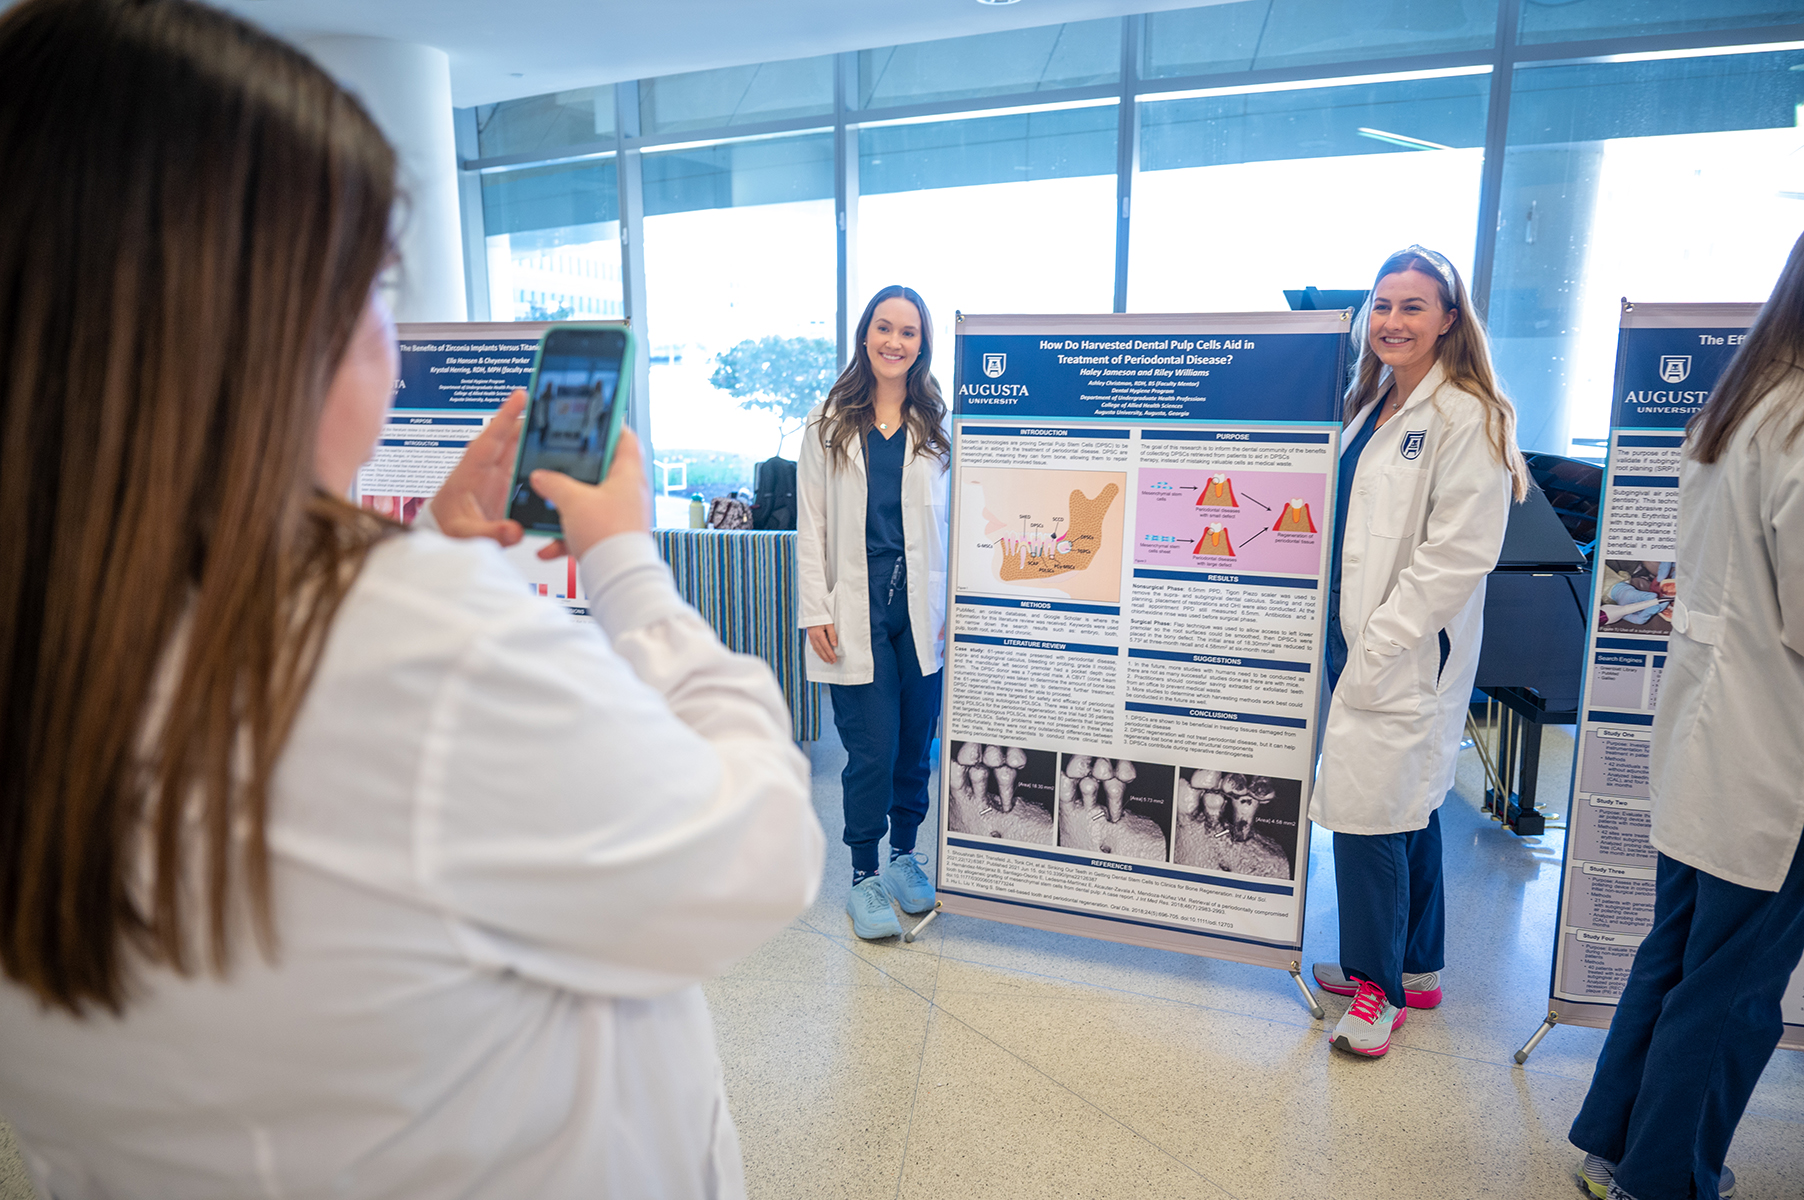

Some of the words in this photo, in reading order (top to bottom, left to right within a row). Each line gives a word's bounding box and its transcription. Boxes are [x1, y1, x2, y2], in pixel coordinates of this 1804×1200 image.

[1040, 340, 1063, 349] How
[1065, 340, 1079, 350] Do
[1081, 341, 1132, 350] Harvested
[1134, 340, 1168, 350] Dental
[1170, 340, 1194, 350] Pulp
[1196, 340, 1221, 350] Cells
[1223, 340, 1242, 349] Aid
[1244, 340, 1254, 349] in
[1699, 335, 1724, 345] The
[1727, 335, 1747, 345] Eff
[1057, 355, 1109, 364] Treatment
[1111, 354, 1123, 364] of
[1124, 355, 1184, 364] Periodontal
[1186, 355, 1233, 364] Disease?
[1154, 369, 1174, 377] Riley
[959, 384, 1029, 396] AUGUSTA
[1624, 391, 1709, 403] AUGUST
[1003, 639, 1040, 648] LITERATURE
[1042, 641, 1066, 650] REVIEW
[1193, 655, 1241, 665] SUGGESTIONS
[1189, 709, 1238, 720] CONCLUSIONS
[1215, 749, 1254, 758] dentinogenesis
[1091, 860, 1132, 871] REFERENCES
[1601, 933, 1615, 942] Four
